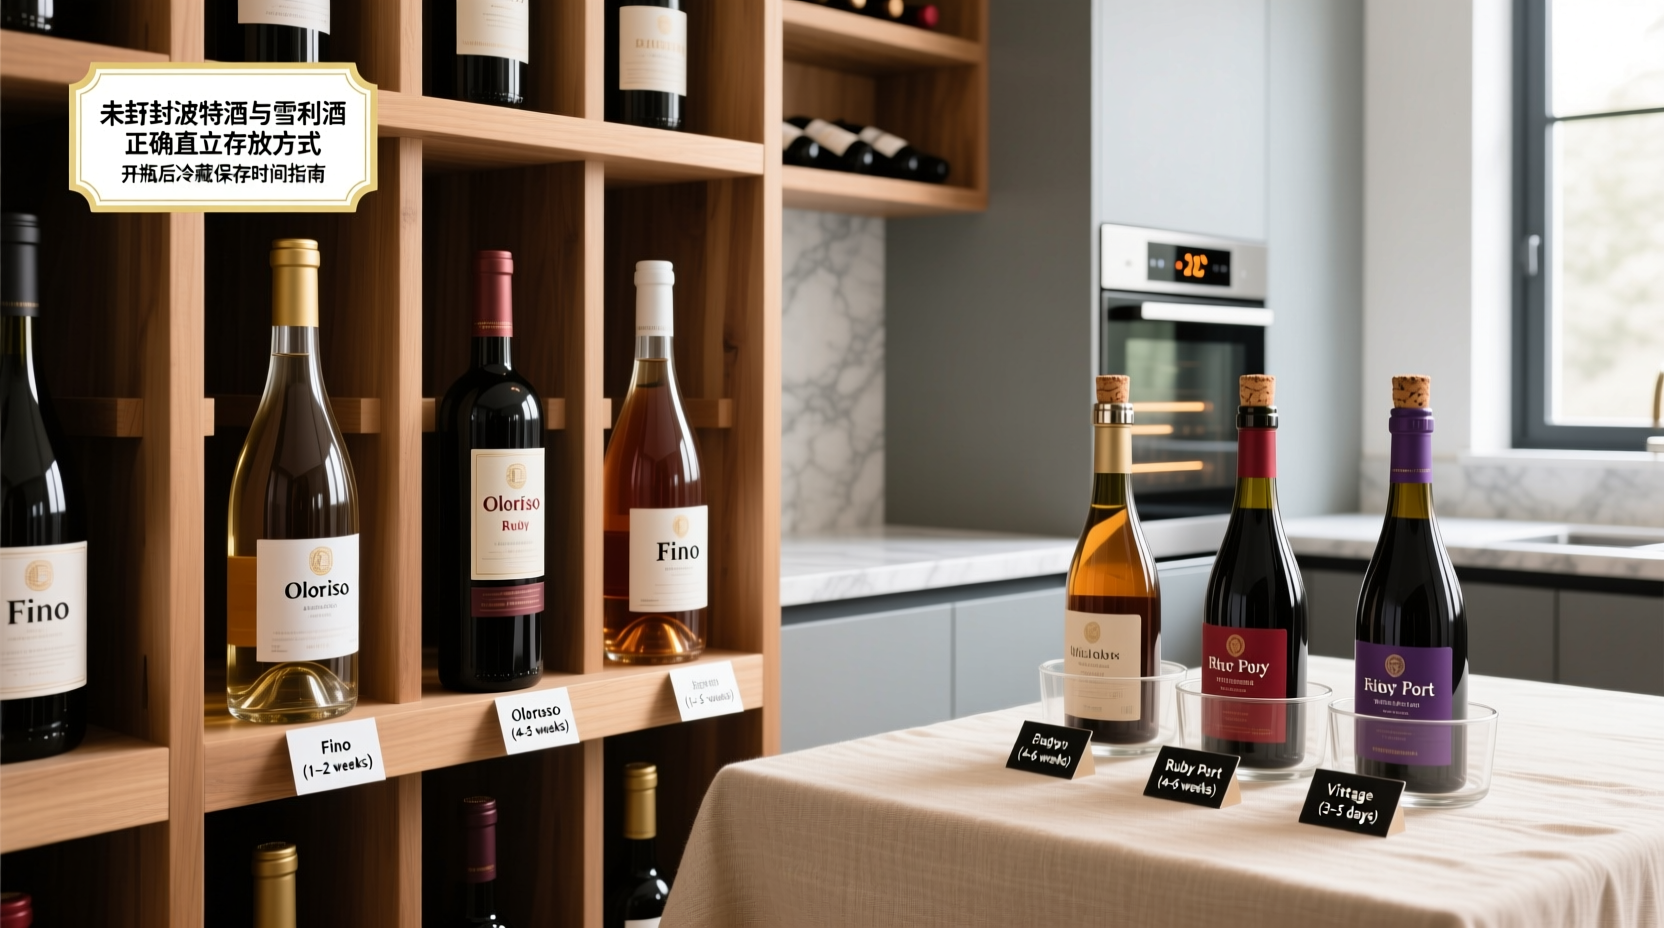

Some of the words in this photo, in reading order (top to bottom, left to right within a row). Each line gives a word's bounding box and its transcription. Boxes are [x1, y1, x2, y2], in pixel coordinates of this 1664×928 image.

[656, 541, 700, 561] Fino
[284, 579, 350, 599] Oloriso
[6, 598, 70, 625] Fino
[1402, 680, 1435, 697] Port
[321, 738, 351, 755] Fino
[333, 753, 373, 773] weeks)
[1165, 758, 1196, 777] Ruby
[1346, 805, 1378, 825] days)
